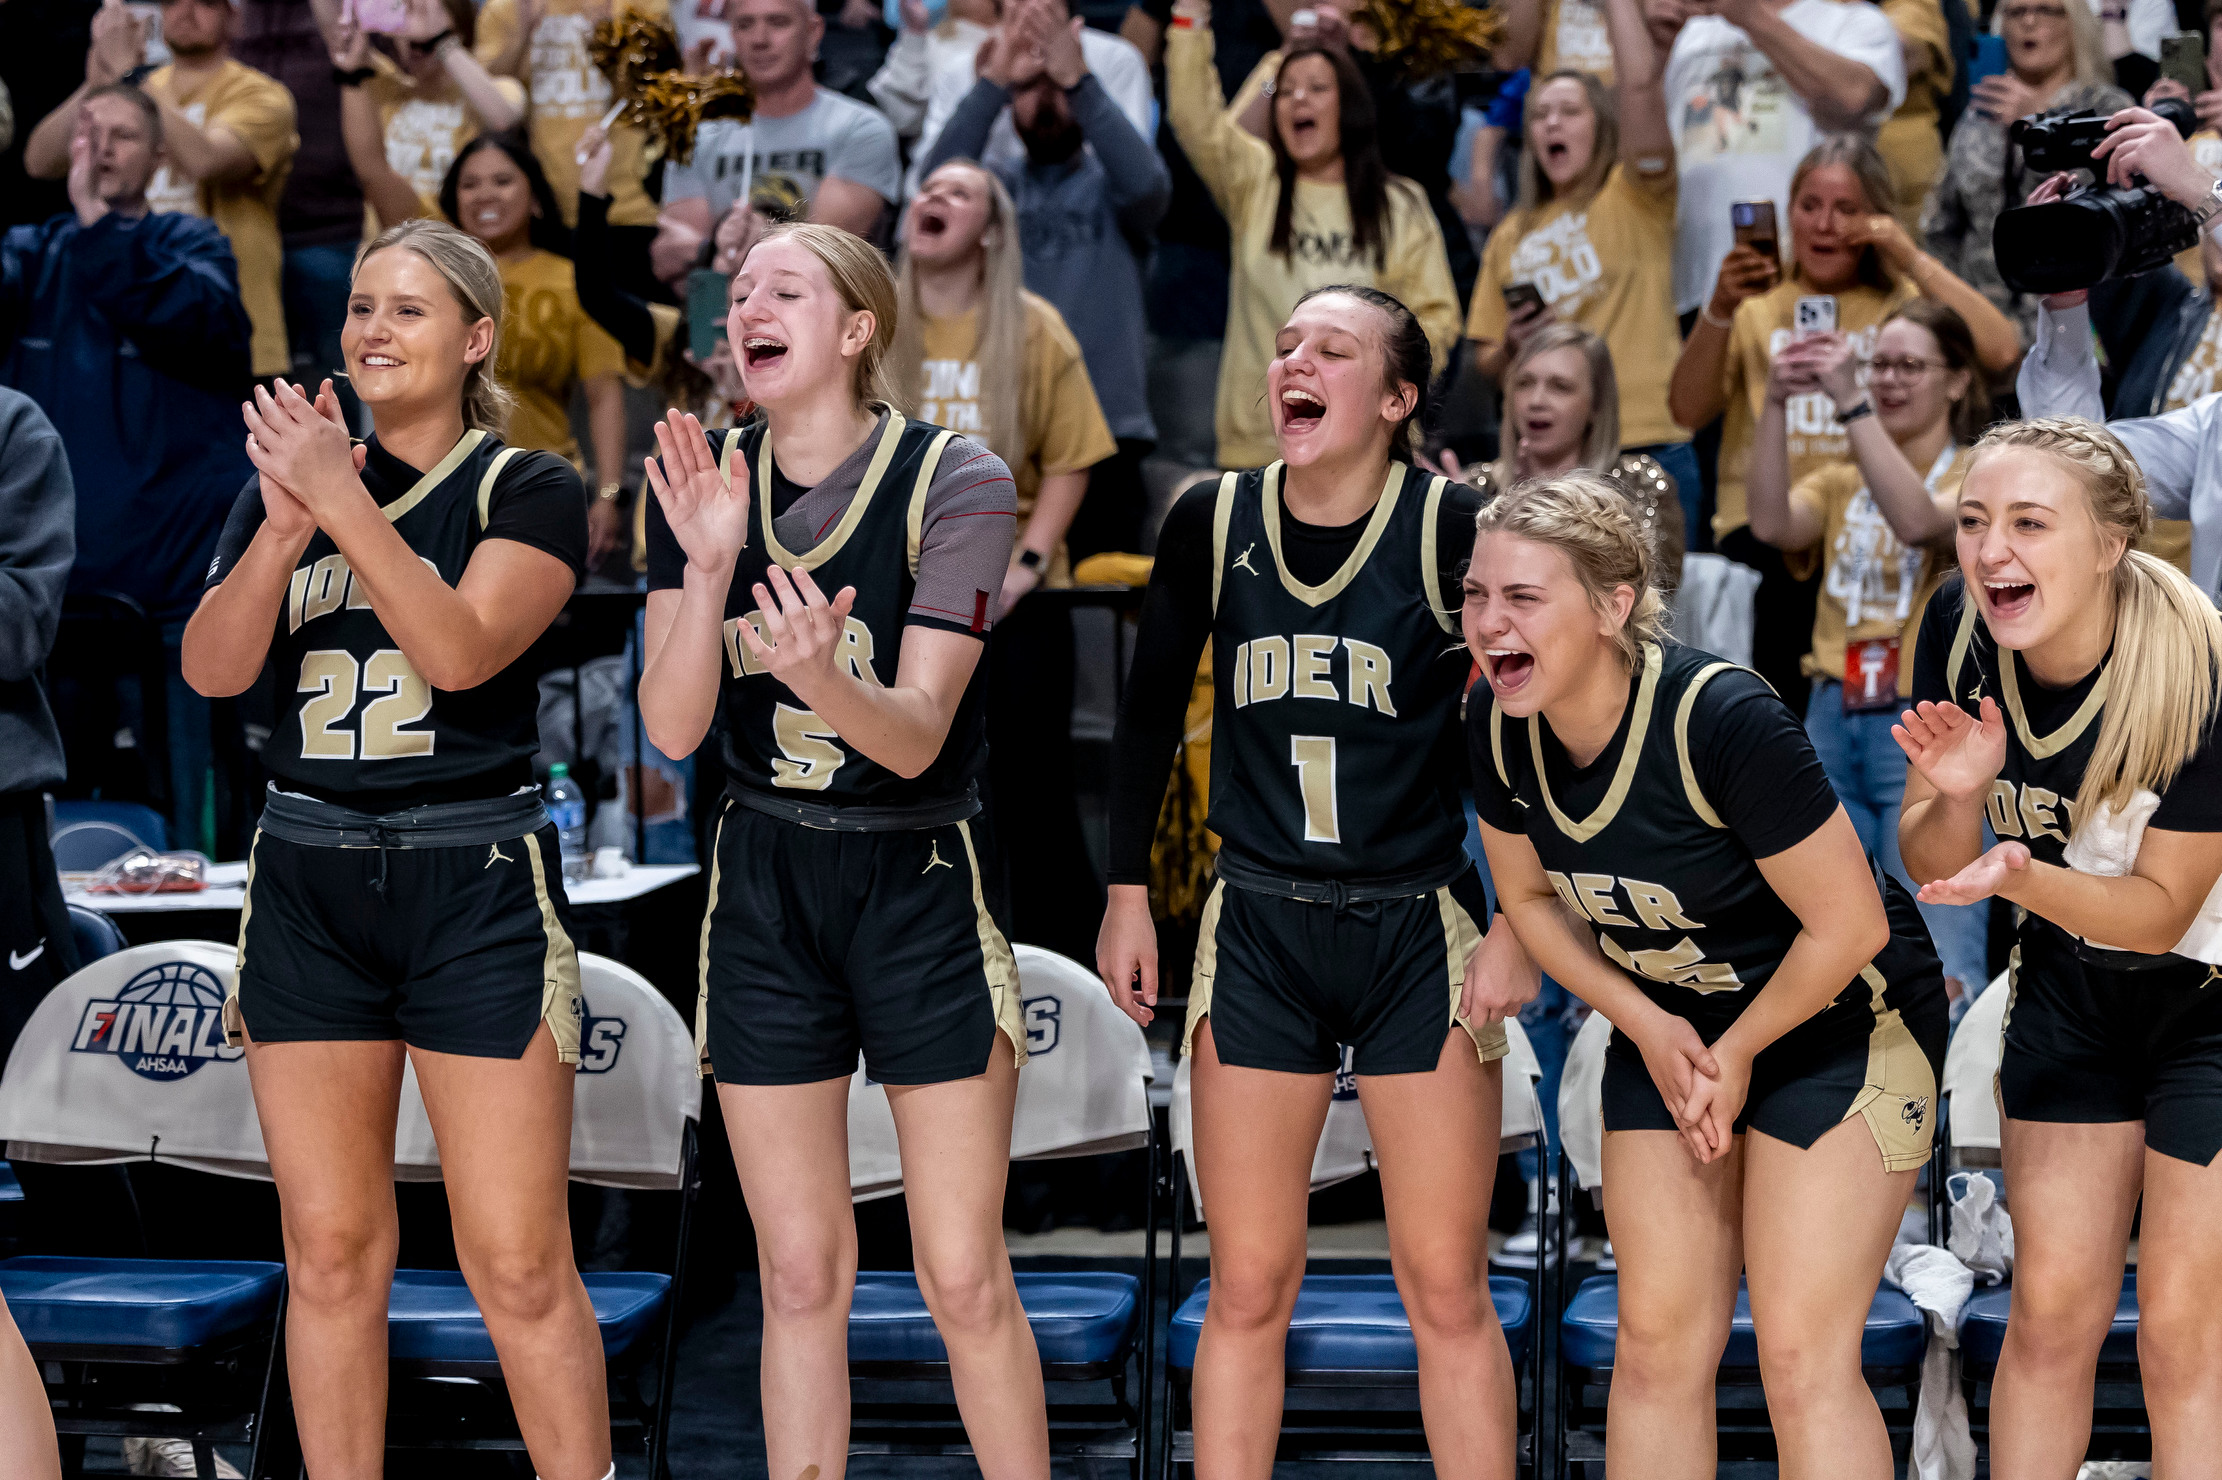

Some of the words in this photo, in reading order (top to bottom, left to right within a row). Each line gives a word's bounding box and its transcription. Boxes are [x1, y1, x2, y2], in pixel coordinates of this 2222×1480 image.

[723, 605, 885, 688] IDR
[1234, 634, 1398, 718] IDER
[296, 649, 437, 761] 22
[770, 702, 846, 791] 5
[1290, 734, 1342, 844] 1
[1543, 868, 1707, 930] DER
[74, 1002, 245, 1059] FINAL
[135, 1056, 189, 1074] AHSAA
